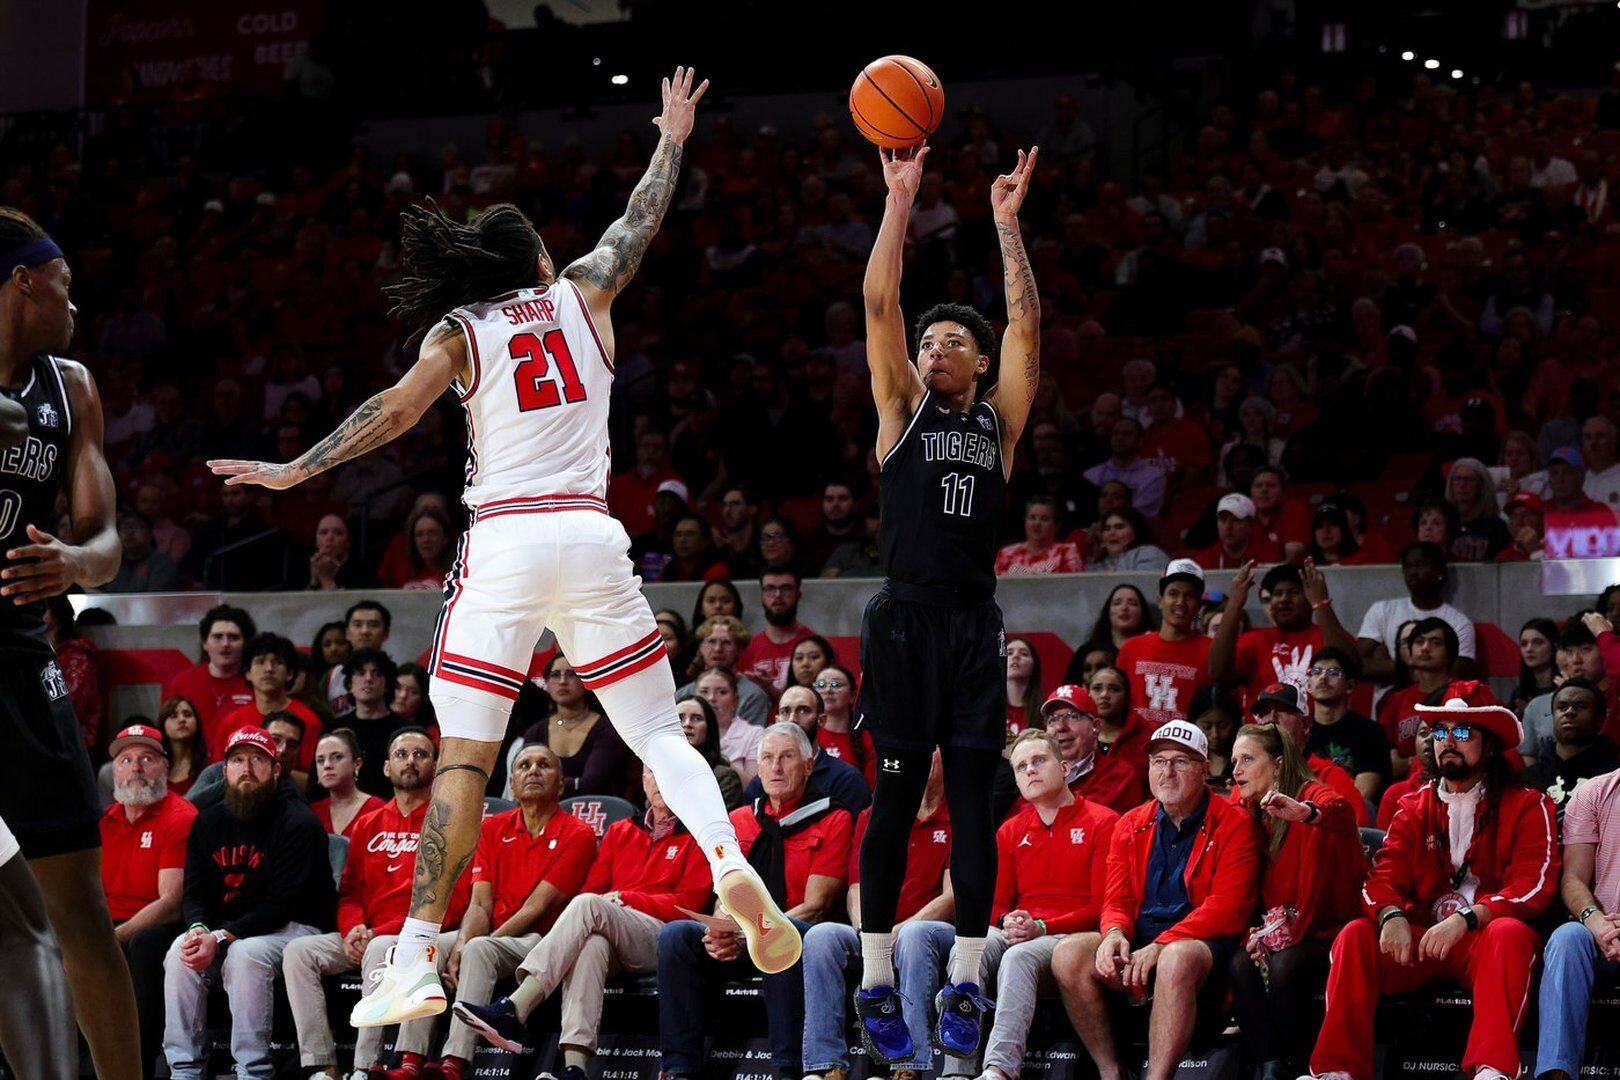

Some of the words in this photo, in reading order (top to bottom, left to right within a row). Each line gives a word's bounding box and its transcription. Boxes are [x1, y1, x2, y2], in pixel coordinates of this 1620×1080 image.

[235, 9, 301, 36] COLD
[501, 299, 555, 325] SHARP
[508, 328, 588, 412] 21
[921, 431, 997, 470] TIGERS
[941, 472, 975, 517] 11
[1156, 726, 1193, 741] GOOD
[622, 1048, 645, 1057] Jack
[745, 1050, 753, 1059] &
[754, 1050, 773, 1060] Jac
[474, 1067, 510, 1077] FL4:1:14
[1402, 1061, 1417, 1071] DJ
[602, 1069, 639, 1080] FL4:1:15
